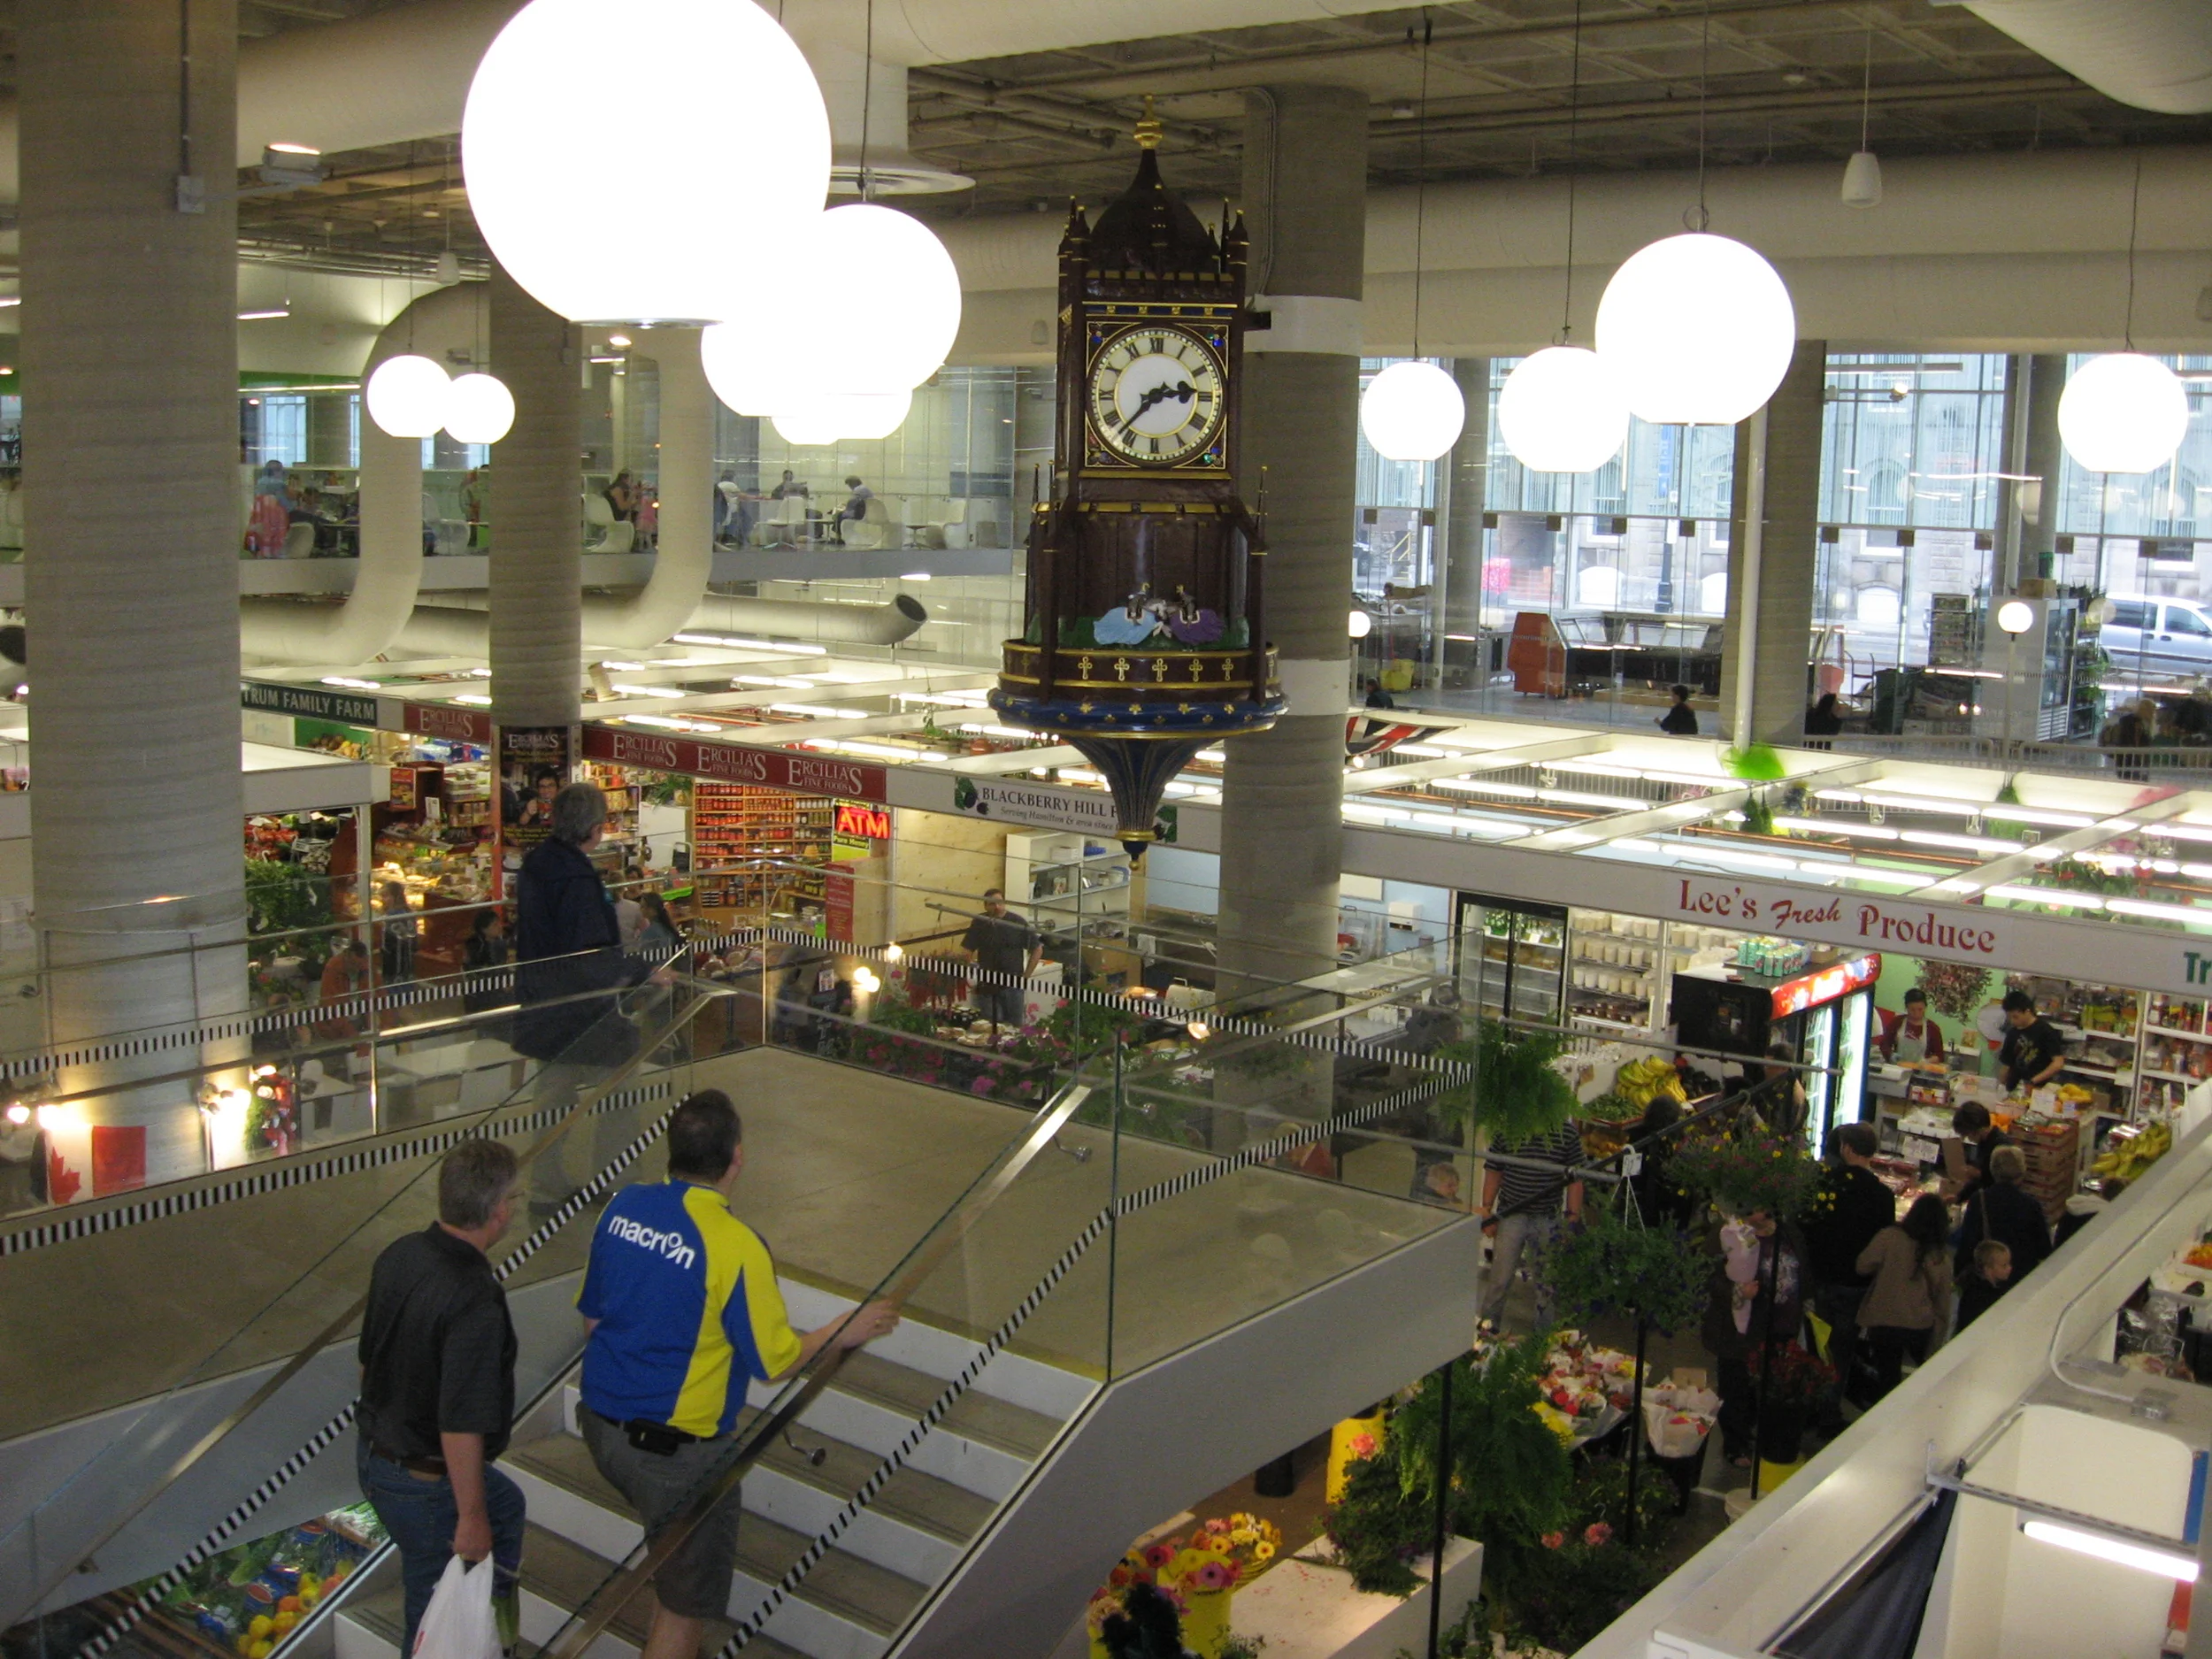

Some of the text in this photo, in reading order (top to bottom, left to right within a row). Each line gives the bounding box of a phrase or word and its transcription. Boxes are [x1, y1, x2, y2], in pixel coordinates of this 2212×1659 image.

[283, 692, 331, 714] FAMILY
[336, 700, 375, 720] FARM
[612, 733, 677, 767] ERCILIA'S
[696, 745, 766, 780] ERCILIA'S
[787, 758, 863, 795] ERCILIA'S
[982, 787, 1071, 811] BLACKBERRY
[1074, 800, 1107, 818] HILL
[1001, 806, 1027, 820] Serving
[1029, 810, 1064, 824] Hamilton
[1065, 815, 1074, 825] &
[1075, 818, 1093, 828] area
[1094, 819, 1113, 830] since
[838, 807, 889, 839] ATM
[1679, 879, 1995, 954] Lee's Fresh Produce
[608, 1215, 695, 1270] macron
